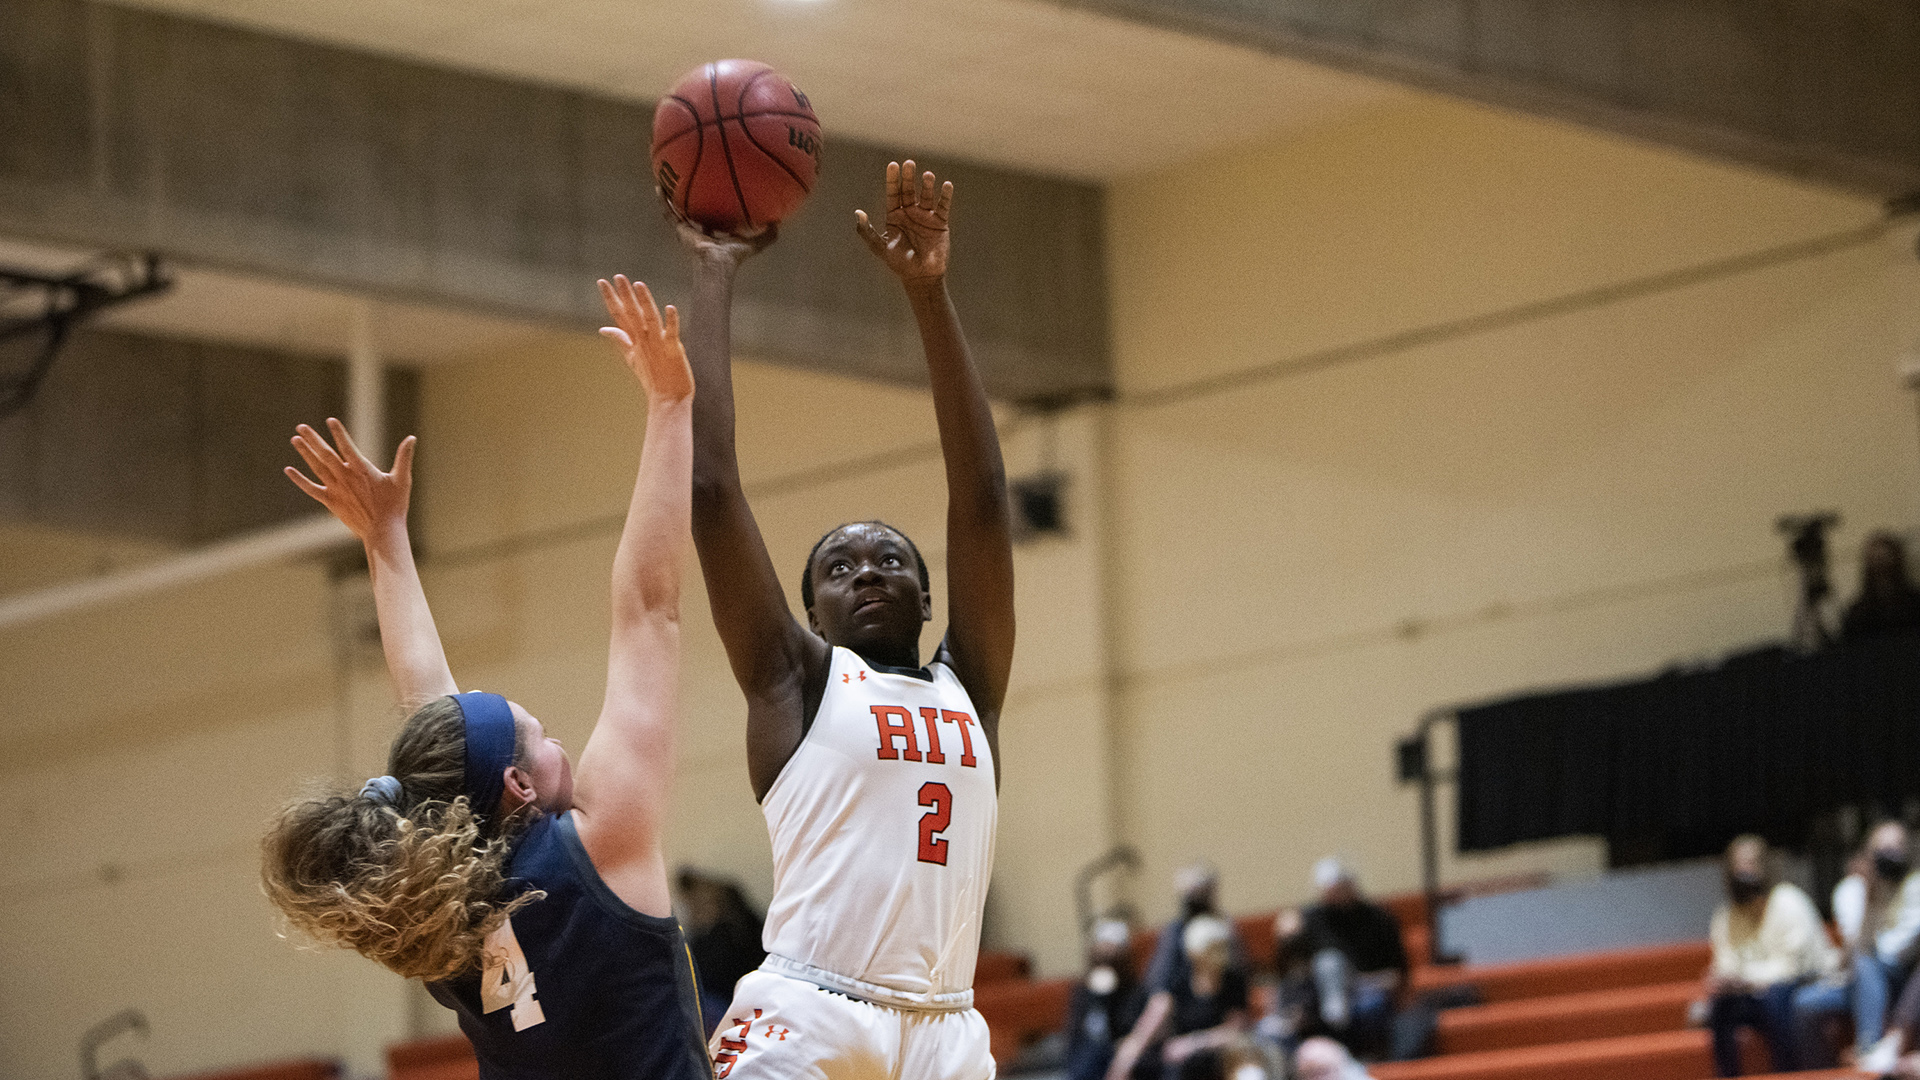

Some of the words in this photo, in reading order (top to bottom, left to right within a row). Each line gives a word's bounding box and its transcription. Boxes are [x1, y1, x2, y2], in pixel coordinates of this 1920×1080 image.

[870, 705, 977, 768] RIT
[917, 781, 952, 866] 2
[480, 913, 546, 1032] 4
